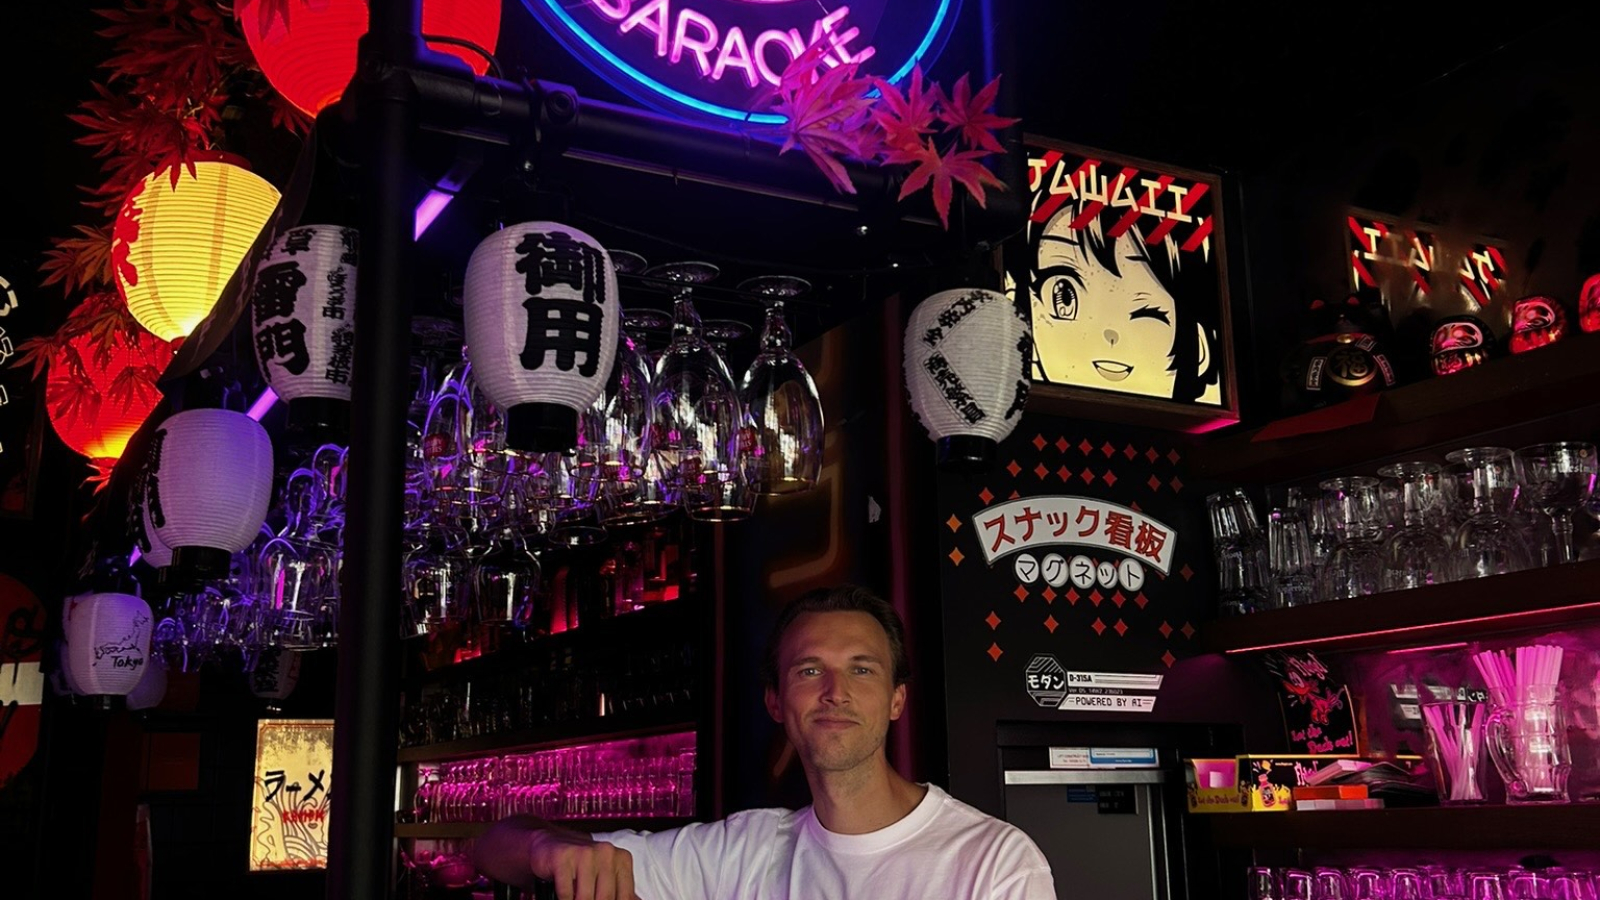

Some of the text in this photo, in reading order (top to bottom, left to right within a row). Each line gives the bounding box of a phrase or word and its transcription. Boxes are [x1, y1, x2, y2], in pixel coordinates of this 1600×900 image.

[590, 0, 876, 87] ARAOKE
[515, 231, 606, 378] 御用
[984, 506, 1168, 563] スナック看板
[1018, 559, 1140, 587] マグネット
[110, 656, 143, 670] Tokyo
[1028, 674, 1065, 690] モダン
[1076, 697, 1142, 708] POWERED BY AI
